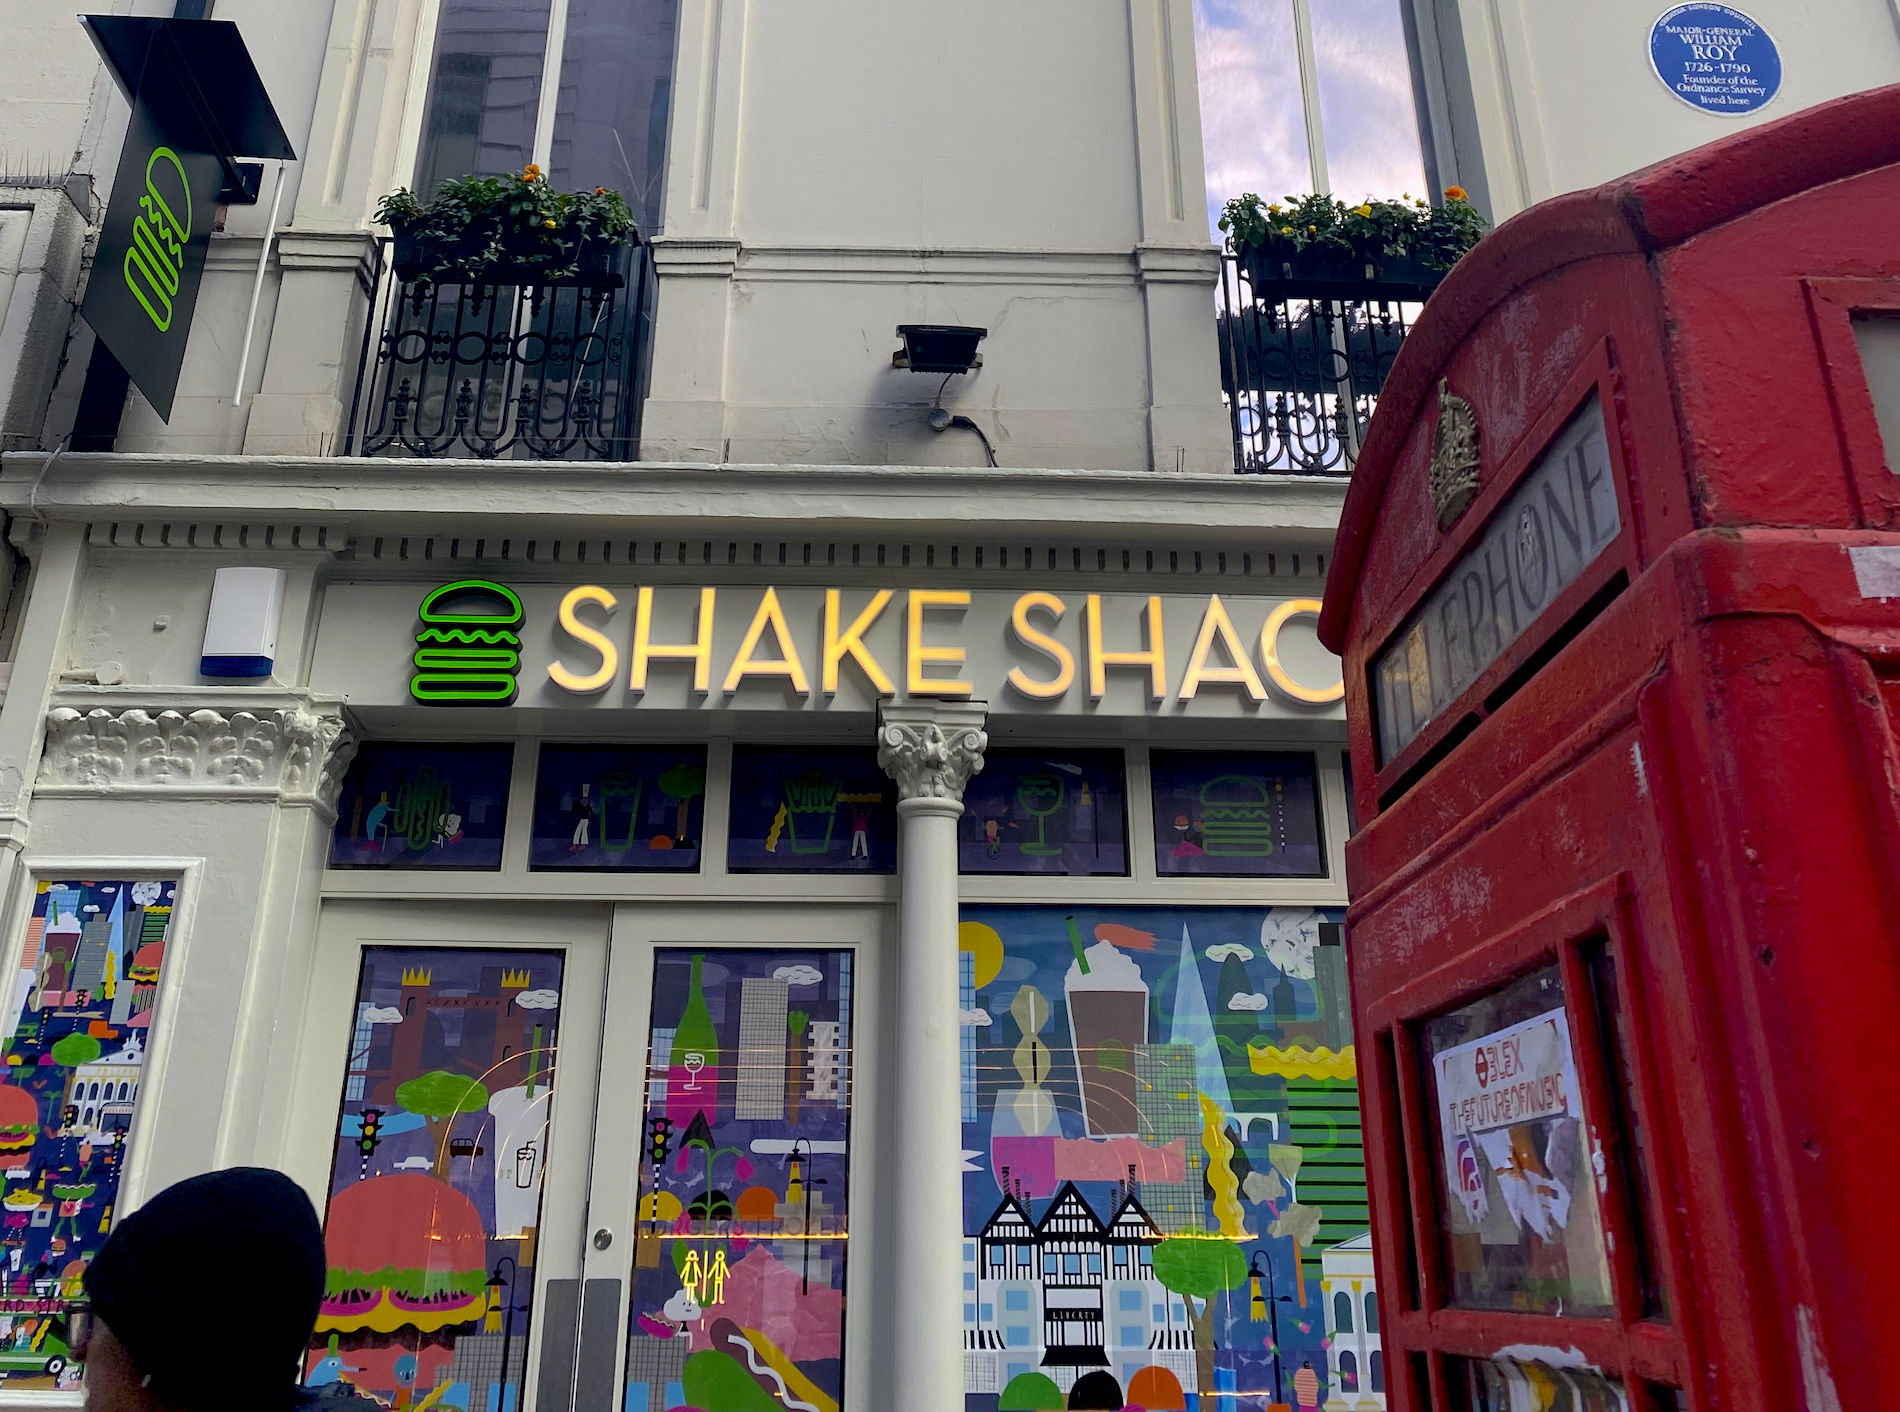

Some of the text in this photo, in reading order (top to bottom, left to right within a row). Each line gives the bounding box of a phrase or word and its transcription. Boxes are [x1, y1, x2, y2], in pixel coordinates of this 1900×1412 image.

[1688, 4, 1721, 12] LONDON
[1724, 9, 1757, 30] COUNCIL
[1679, 34, 1743, 46] WILLIAM
[1691, 44, 1738, 61] ROY
[1682, 74, 1759, 86] Founder of the
[1676, 83, 1767, 97] Ordnance Survey
[1700, 94, 1750, 106] lived here
[547, 585, 976, 699] SHAKE
